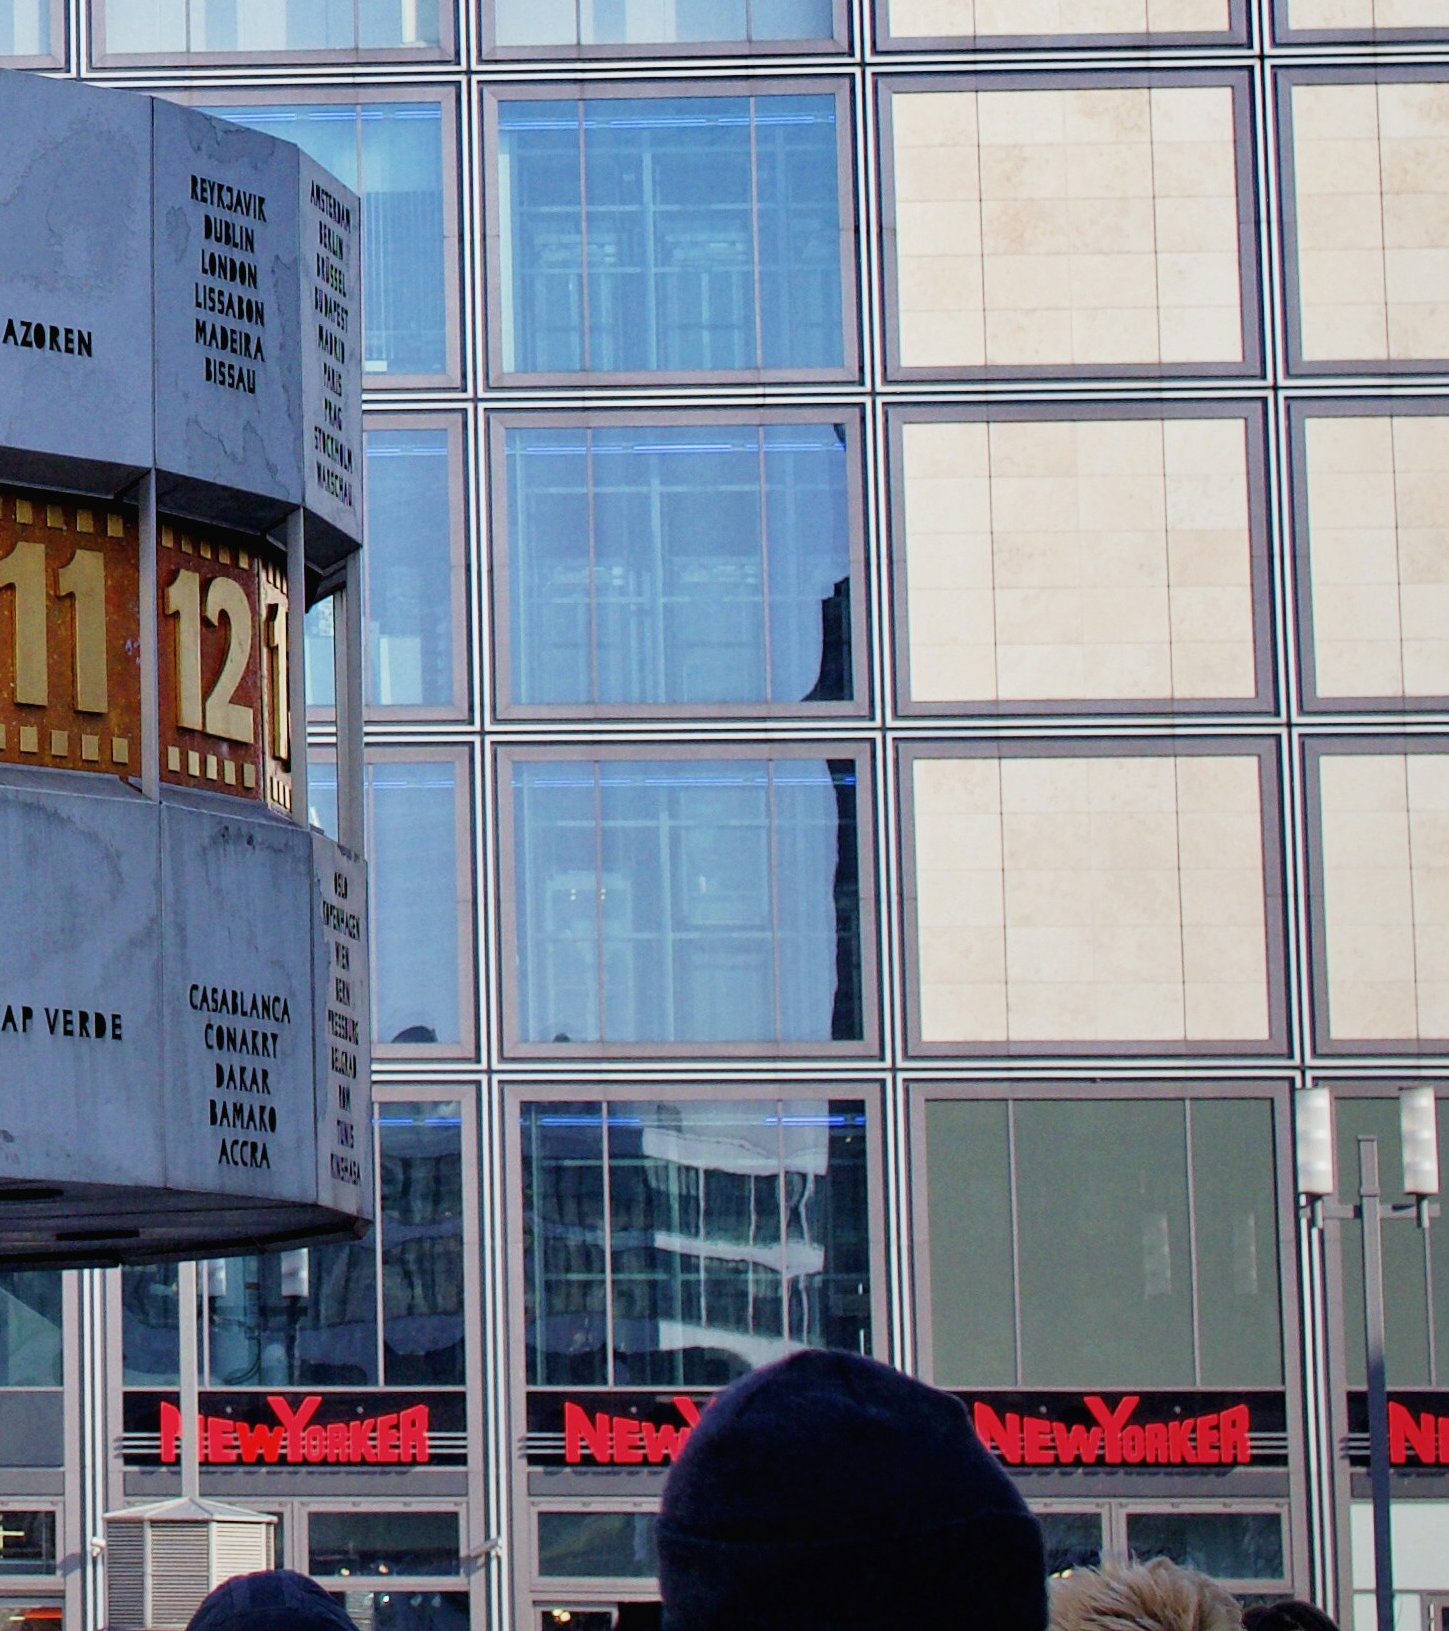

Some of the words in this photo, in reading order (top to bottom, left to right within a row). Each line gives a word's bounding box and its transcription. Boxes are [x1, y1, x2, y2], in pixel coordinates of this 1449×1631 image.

[190, 174, 267, 222] REYKJAVIK
[310, 180, 350, 233] AMSTERDAM
[204, 215, 255, 253] DUBLIN
[319, 221, 343, 260] BERLIN
[201, 250, 258, 289] LONDON
[195, 284, 265, 327] LISSABON
[315, 286, 349, 332] BUDAPEST
[2, 318, 93, 358] AZOREN
[195, 319, 266, 362] MADEIRA
[318, 324, 344, 364] MADRID
[205, 357, 258, 395] BISSAU
[314, 426, 352, 473] STOCKHOLM
[165, 569, 255, 745] 12
[44, 1007, 123, 1041] VERDE
[189, 983, 291, 1025] CASABLANCA
[204, 1022, 279, 1059] CONAKRY
[215, 1062, 271, 1096] DAKAR
[209, 1099, 277, 1134] BAMAKO
[218, 1138, 271, 1170] ACCRA
